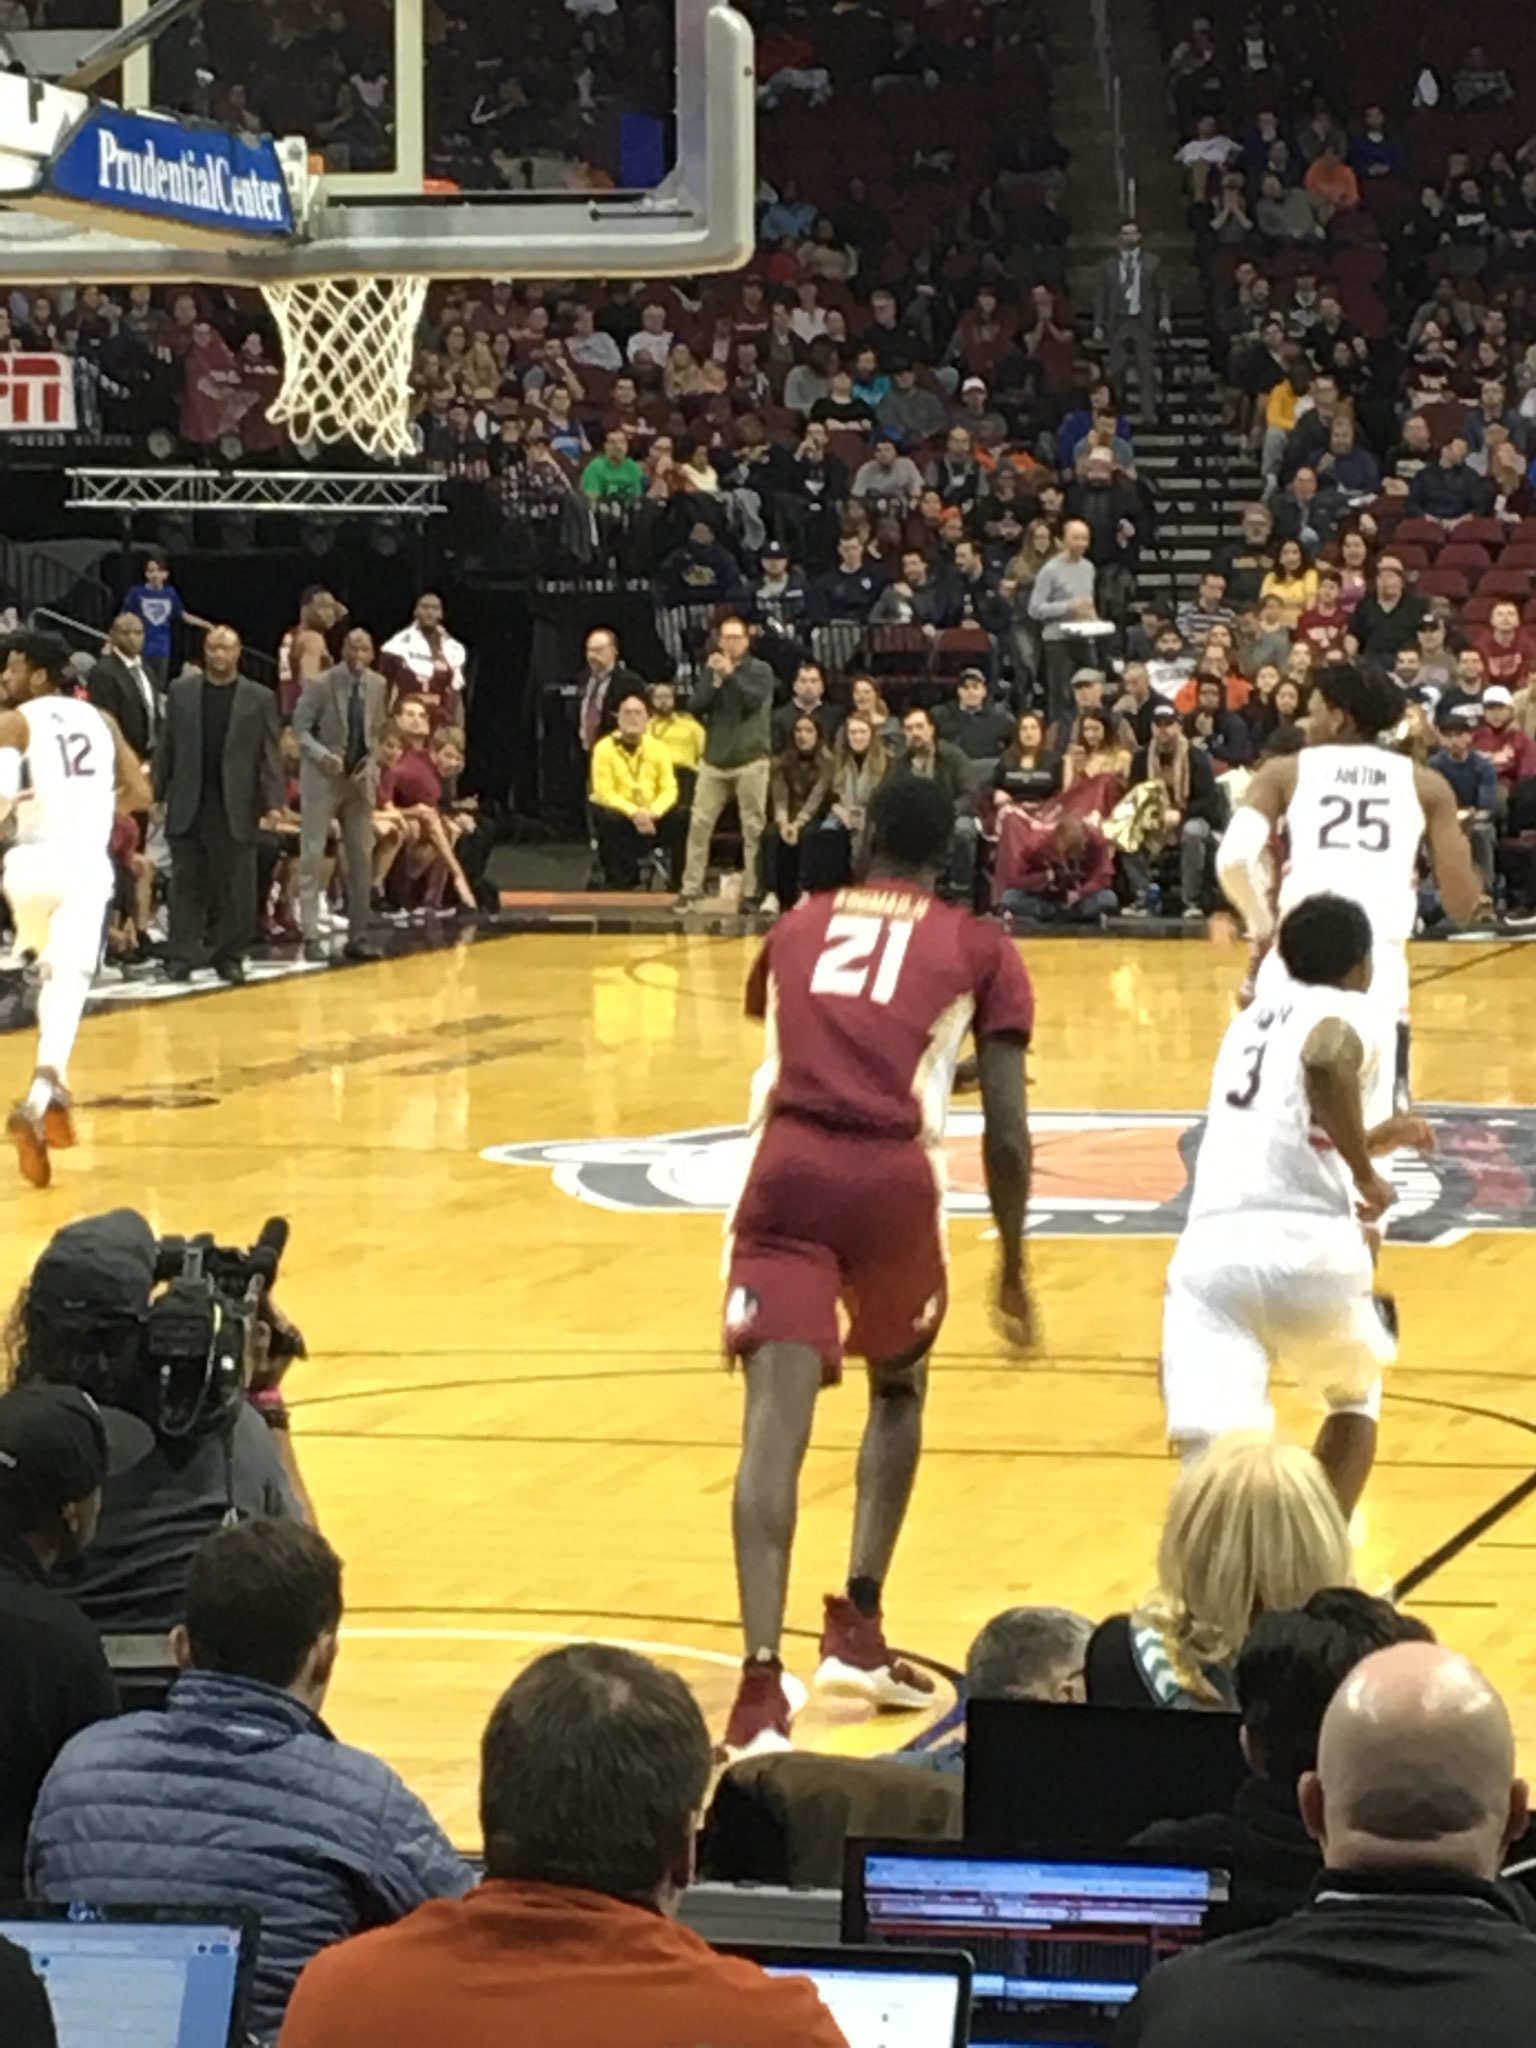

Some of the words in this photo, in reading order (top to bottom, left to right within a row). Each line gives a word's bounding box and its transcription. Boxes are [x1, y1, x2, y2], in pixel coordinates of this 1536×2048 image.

[55, 733, 96, 778] 12
[1318, 794, 1391, 853] 25
[809, 914, 914, 1005] 21
[1225, 1040, 1268, 1111] 3
